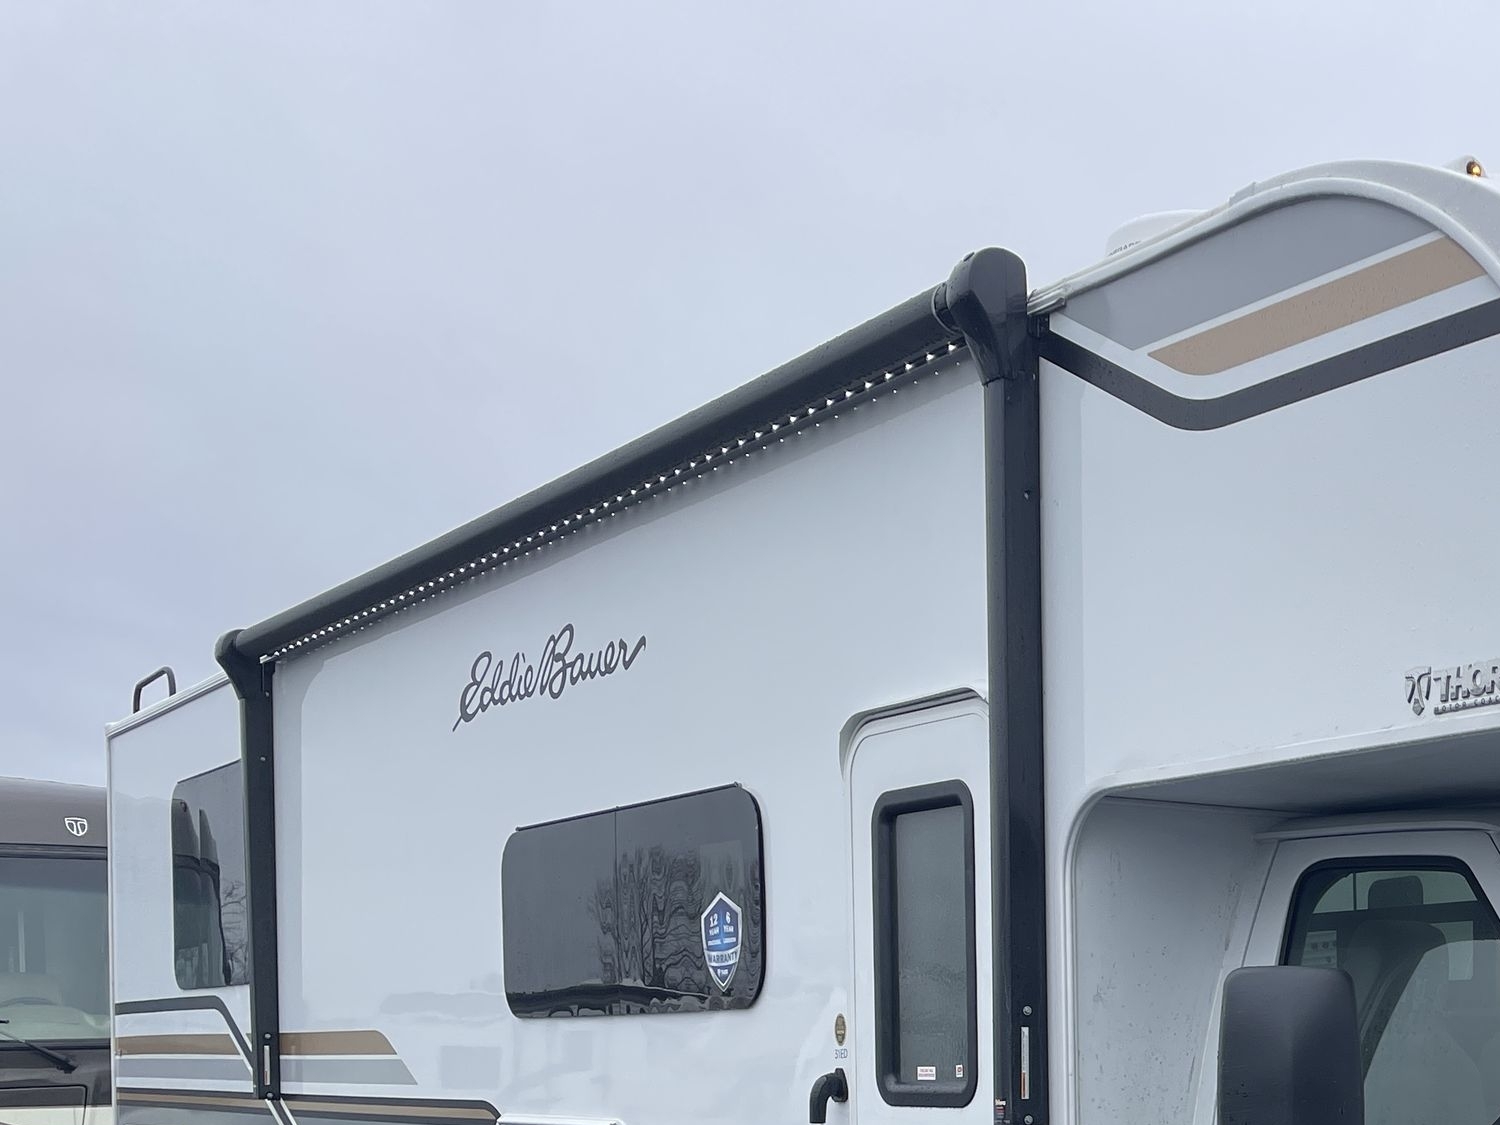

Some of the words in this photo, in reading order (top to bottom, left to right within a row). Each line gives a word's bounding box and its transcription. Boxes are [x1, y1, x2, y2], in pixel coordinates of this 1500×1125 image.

[452, 649, 541, 733] Eddie
[539, 622, 647, 700] Bauer
[1434, 700, 1468, 715] MOTOR
[707, 950, 738, 965] WARRANTY
